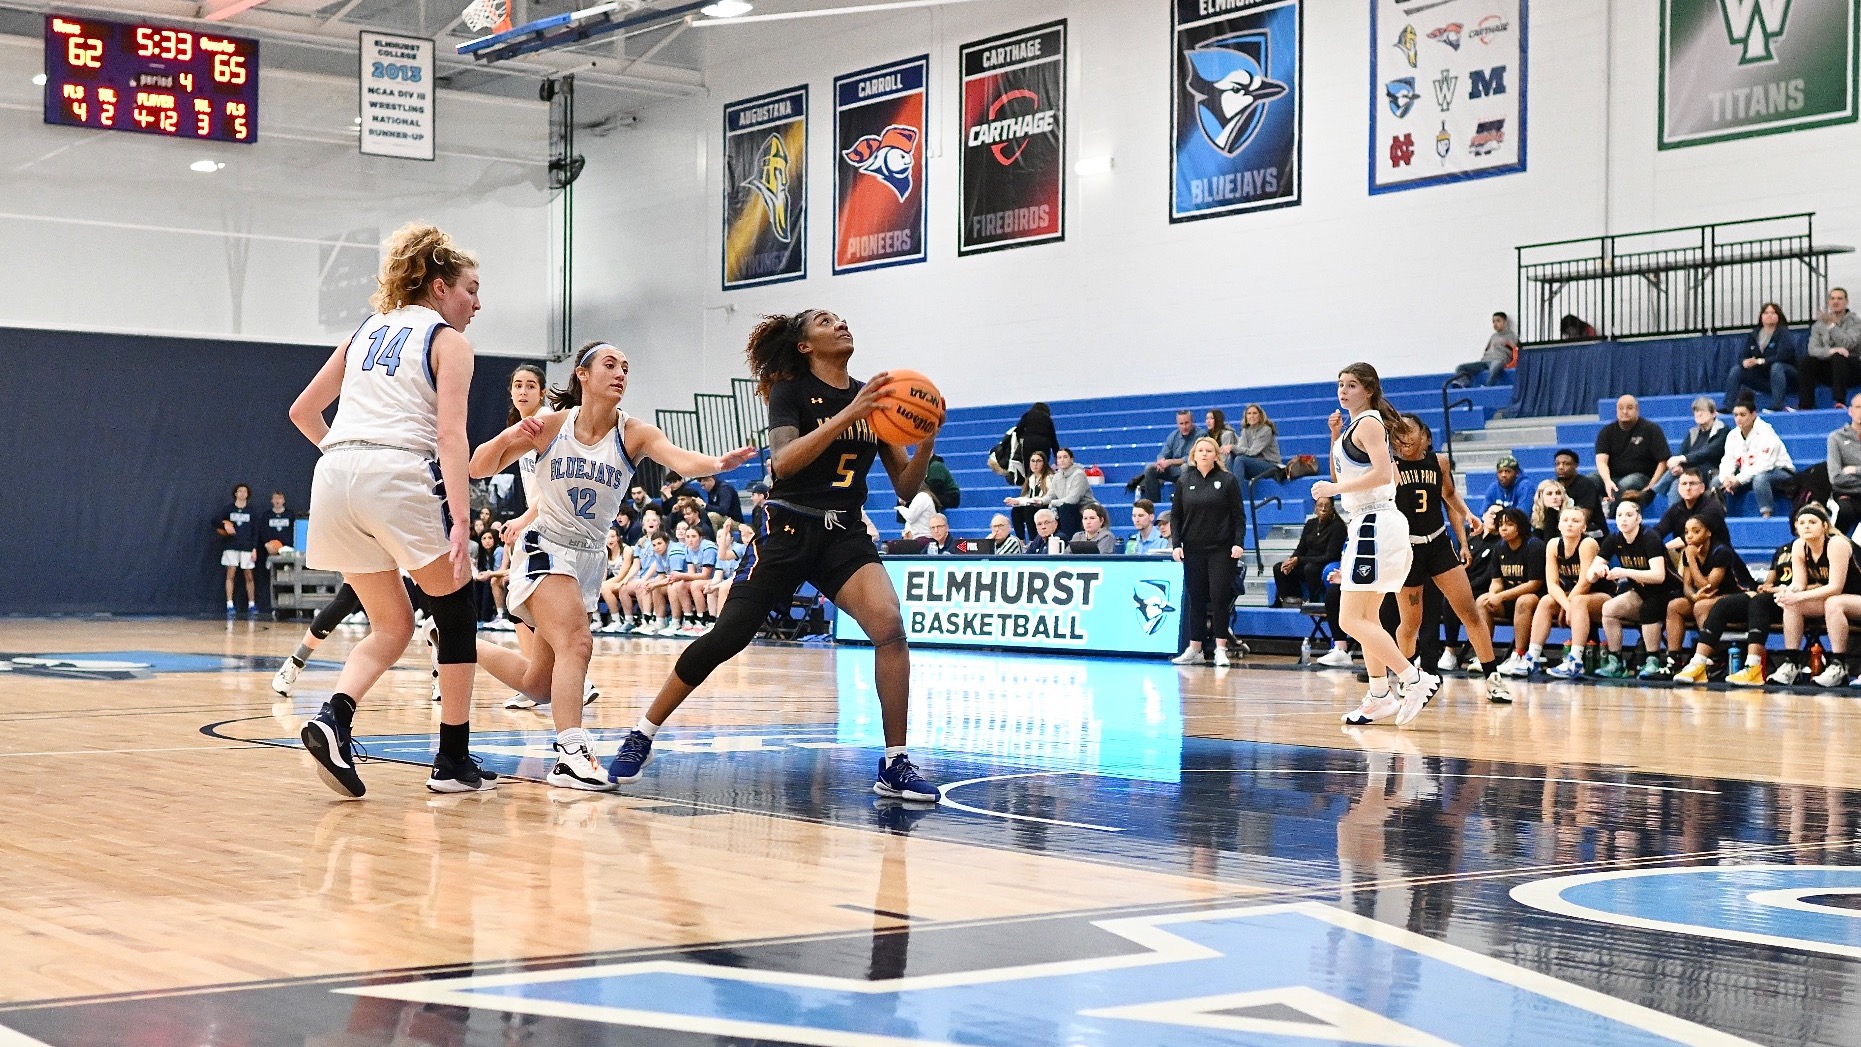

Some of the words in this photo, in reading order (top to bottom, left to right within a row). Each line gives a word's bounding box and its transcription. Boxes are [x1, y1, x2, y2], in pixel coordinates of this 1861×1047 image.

[69, 37, 103, 68] 62
[137, 28, 192, 61] 5:33
[982, 39, 1042, 68] CARTHAGE
[180, 73, 193, 92] 4
[214, 54, 246, 84] 65
[371, 61, 422, 82] 2013
[367, 87, 395, 96] NCAA
[398, 90, 414, 99] DIV
[858, 74, 903, 98] CARROLL
[73, 102, 86, 122] 4
[369, 101, 424, 114] WRESTLING
[739, 101, 792, 126] AUGUSTANA
[1708, 79, 1804, 121] TITANS
[101, 104, 114, 125] 2
[198, 114, 209, 135] 3
[372, 115, 421, 127] NATIONAL
[235, 118, 247, 139] 5
[368, 129, 424, 140] RUNNER-UP
[968, 110, 1055, 147] CARTHAGE
[1191, 168, 1277, 204] BLUEJAYS
[973, 204, 1049, 238] FIREBIRDS
[847, 229, 912, 259] PIONEERS
[362, 325, 413, 376] 14
[910, 387, 939, 409] NCAA
[551, 456, 623, 490] BLUEJAYS
[831, 453, 858, 488] 5
[1400, 470, 1420, 486] ORTH
[567, 486, 597, 519] 12
[1415, 489, 1428, 513] 3
[905, 570, 1100, 606] ELMHURST
[911, 611, 1085, 641] BASKETBALL
